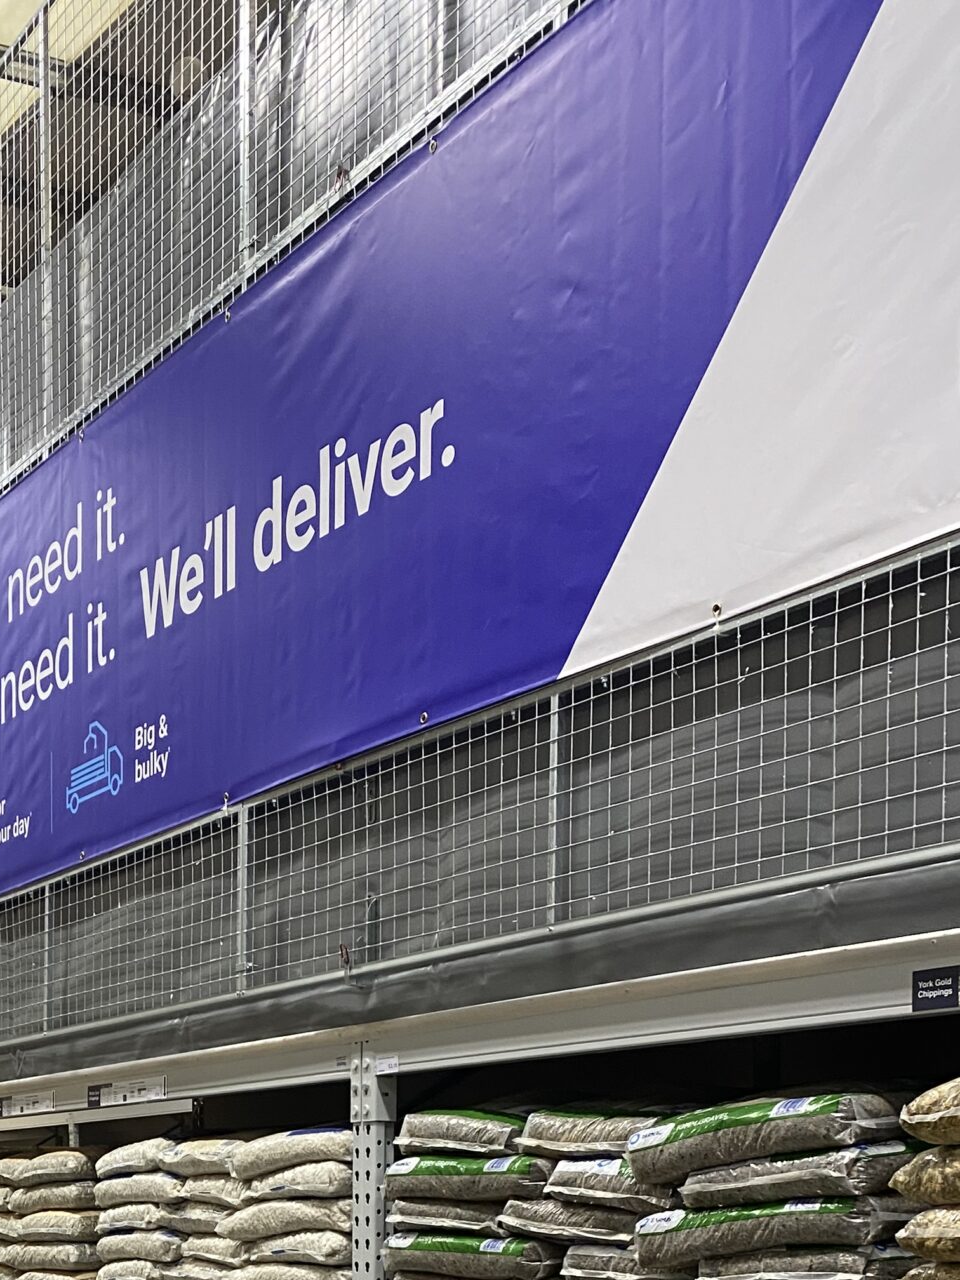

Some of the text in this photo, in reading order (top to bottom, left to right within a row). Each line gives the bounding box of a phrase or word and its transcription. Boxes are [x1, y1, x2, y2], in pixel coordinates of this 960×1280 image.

[253, 398, 456, 573] deliver.
[7, 503, 82, 623] need
[96, 487, 125, 561] it.
[0, 613, 74, 718] need
[86, 601, 115, 673] it.
[135, 714, 168, 750] Big &
[918, 977, 952, 989] York Gold
[918, 988, 952, 998] Chippings
